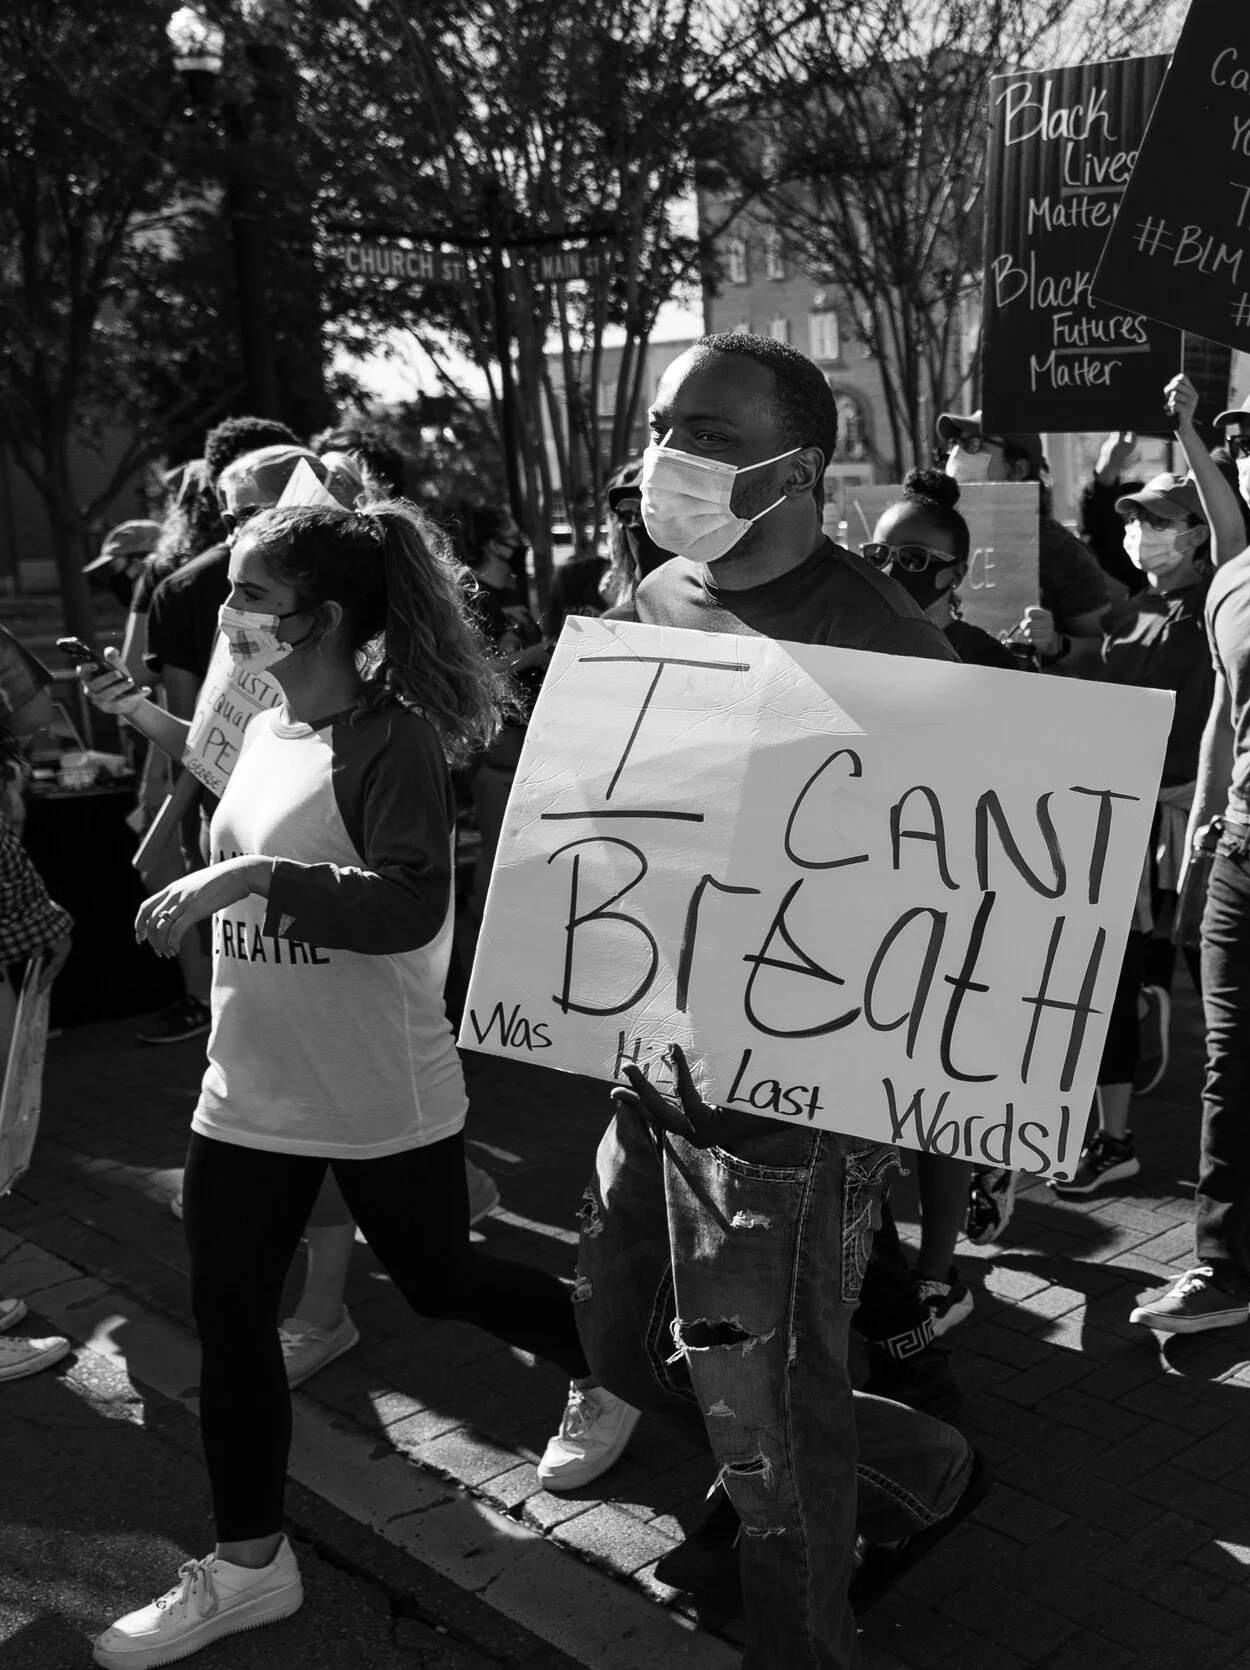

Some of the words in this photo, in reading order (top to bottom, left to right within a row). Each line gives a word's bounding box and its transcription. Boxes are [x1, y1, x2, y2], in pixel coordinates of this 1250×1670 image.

[995, 79, 1118, 147] Black
[344, 246, 435, 281] CHURCH
[441, 261, 465, 282] ST
[541, 254, 581, 279] MAIN
[584, 256, 600, 276] ST
[991, 250, 1097, 311] Black
[1132, 216, 1244, 285] #BLM
[1052, 311, 1148, 347] Futures
[1029, 350, 1122, 393] Matter
[540, 655, 752, 823] I
[784, 747, 1140, 906] CANT
[469, 1000, 553, 1052] Was
[725, 1048, 825, 1121] Last
[881, 1077, 1072, 1182] Words!
